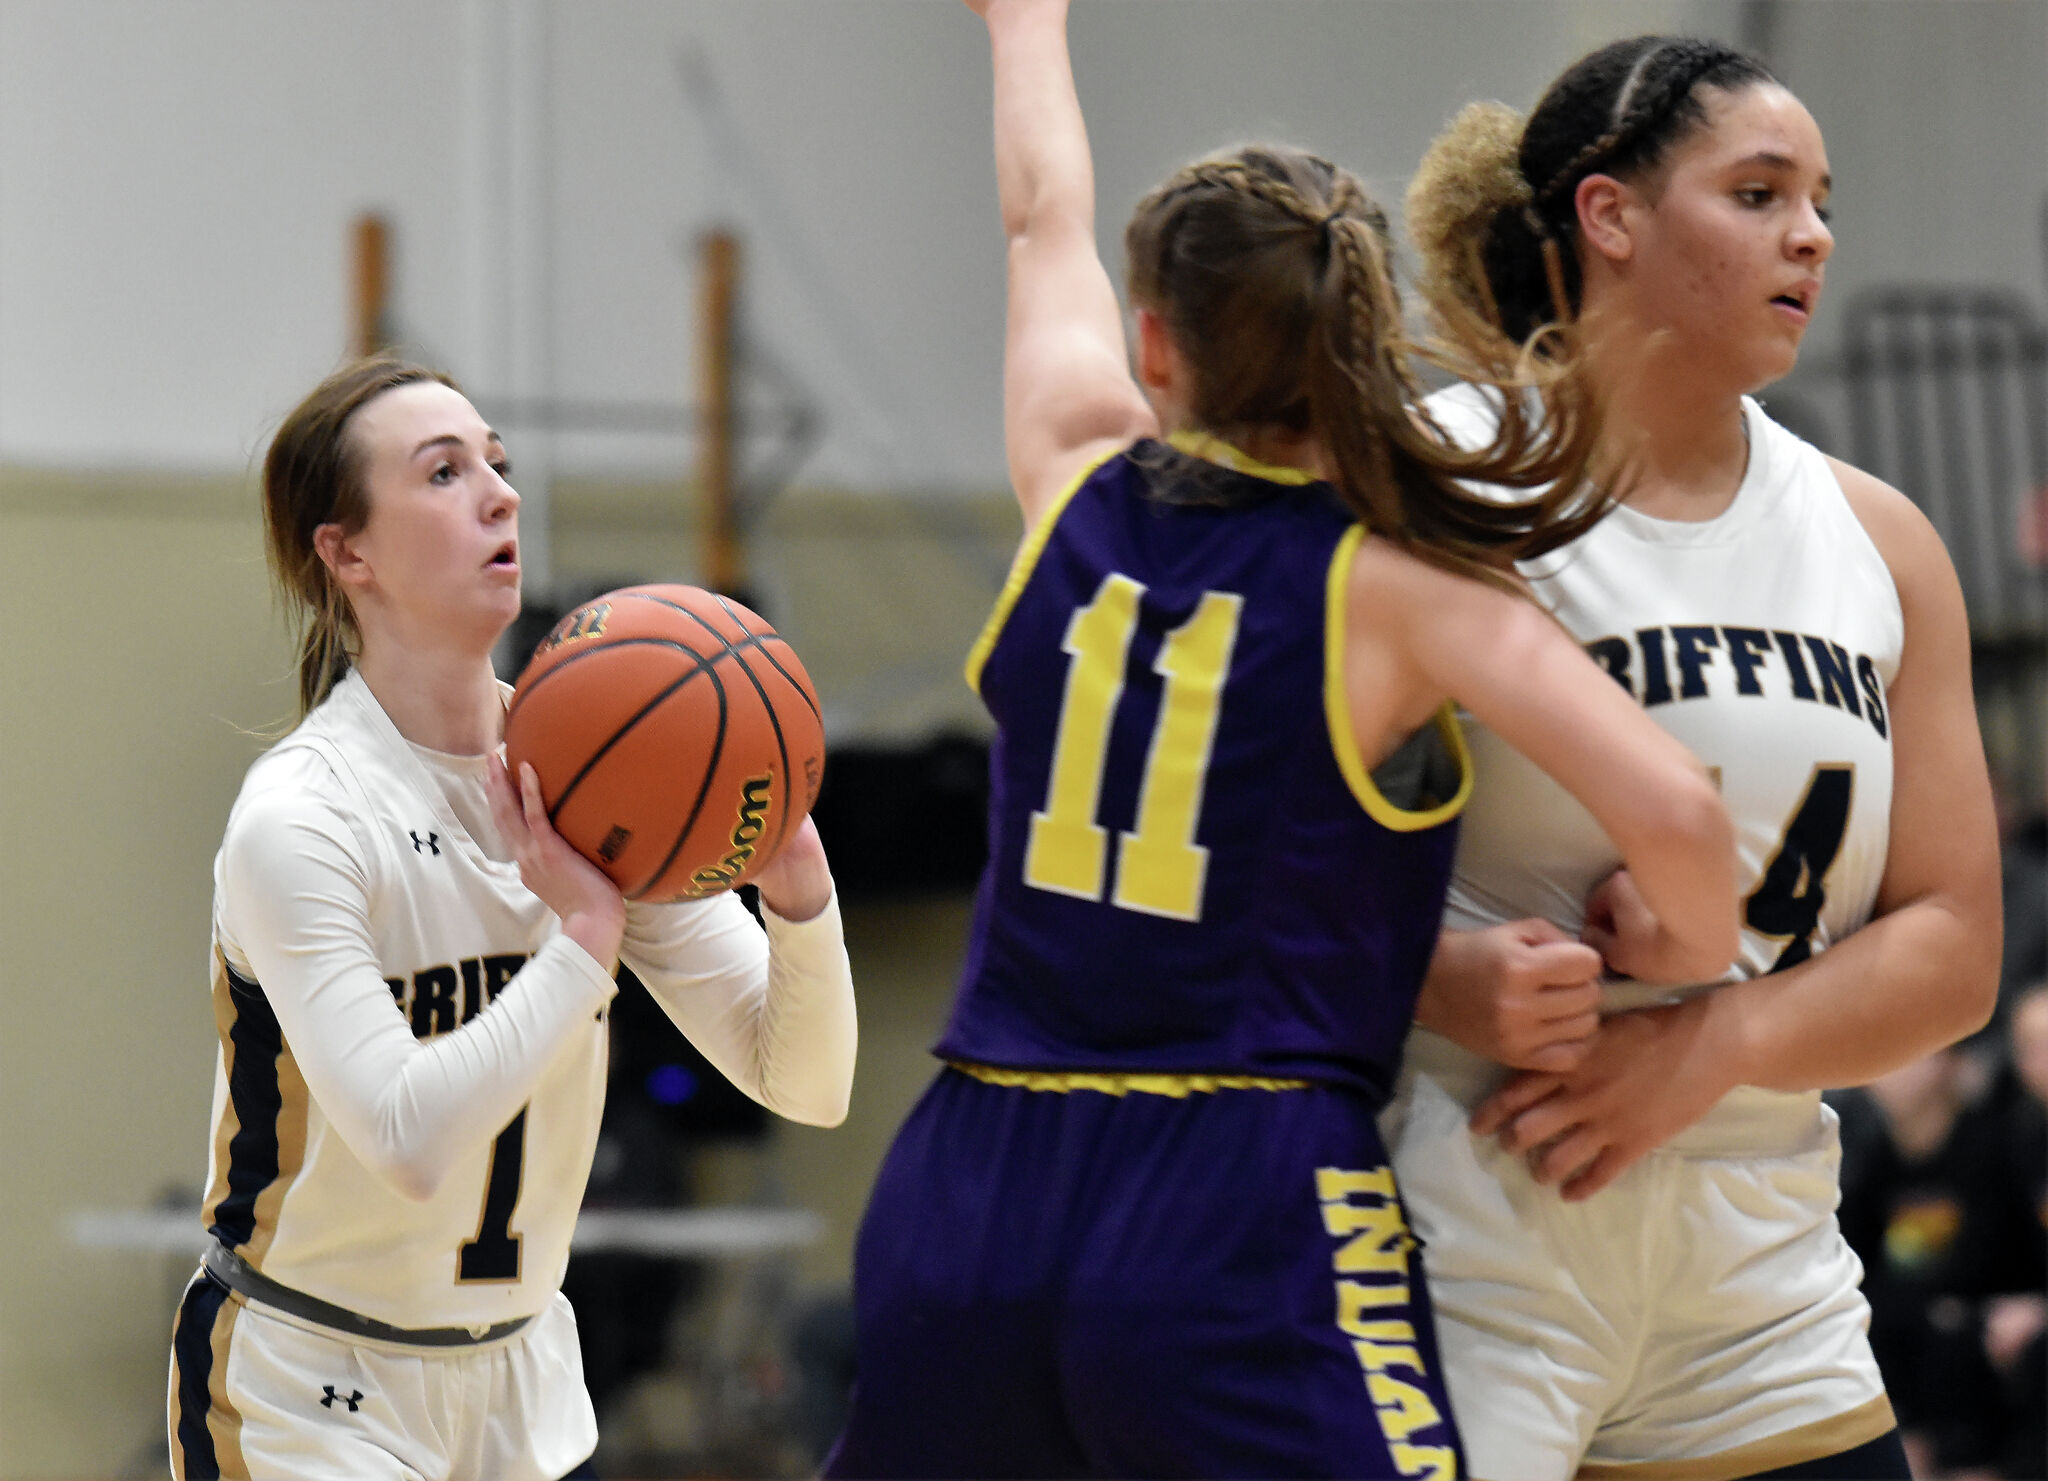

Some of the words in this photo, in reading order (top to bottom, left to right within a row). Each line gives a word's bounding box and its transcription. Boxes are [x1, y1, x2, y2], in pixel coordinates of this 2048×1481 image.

[1023, 572, 1244, 923] 11
[1580, 624, 1888, 741] RIFFINS
[1712, 761, 1856, 975] 4
[454, 1098, 531, 1285] 1
